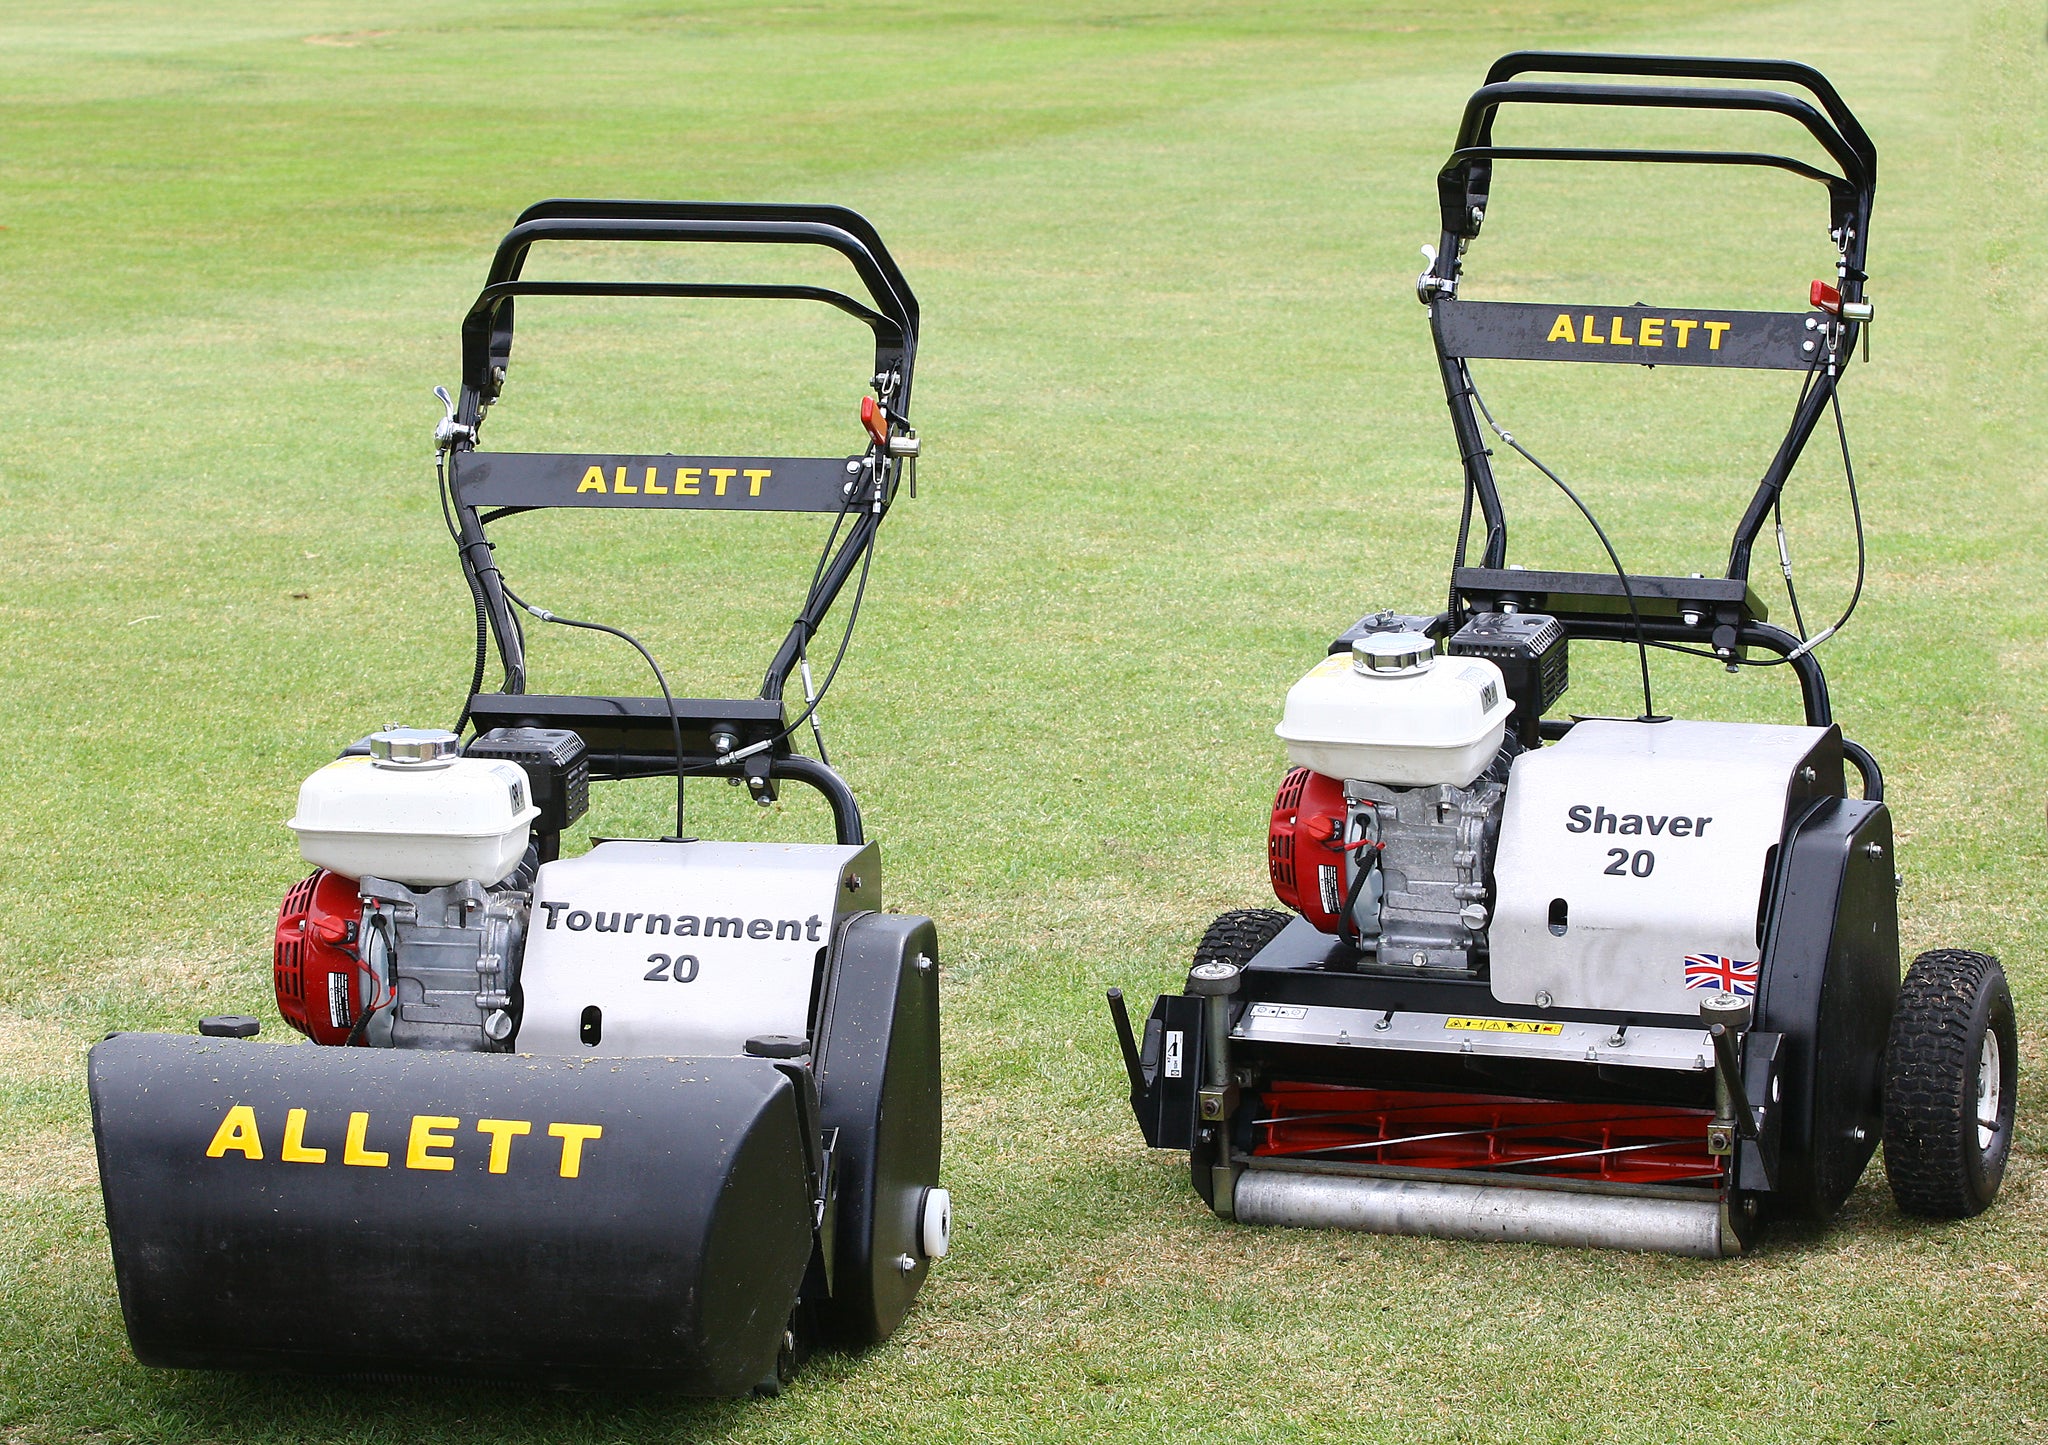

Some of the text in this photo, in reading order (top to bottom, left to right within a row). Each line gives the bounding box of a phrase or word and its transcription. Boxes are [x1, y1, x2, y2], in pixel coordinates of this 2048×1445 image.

[1547, 314, 1731, 351] ALLETT
[577, 466, 771, 497] ALLETT
[1566, 806, 1712, 837] Shaver
[1604, 849, 1655, 877] 20
[542, 902, 823, 941] Tournament
[645, 955, 699, 983] 20
[206, 1106, 602, 1179] ALLETT
